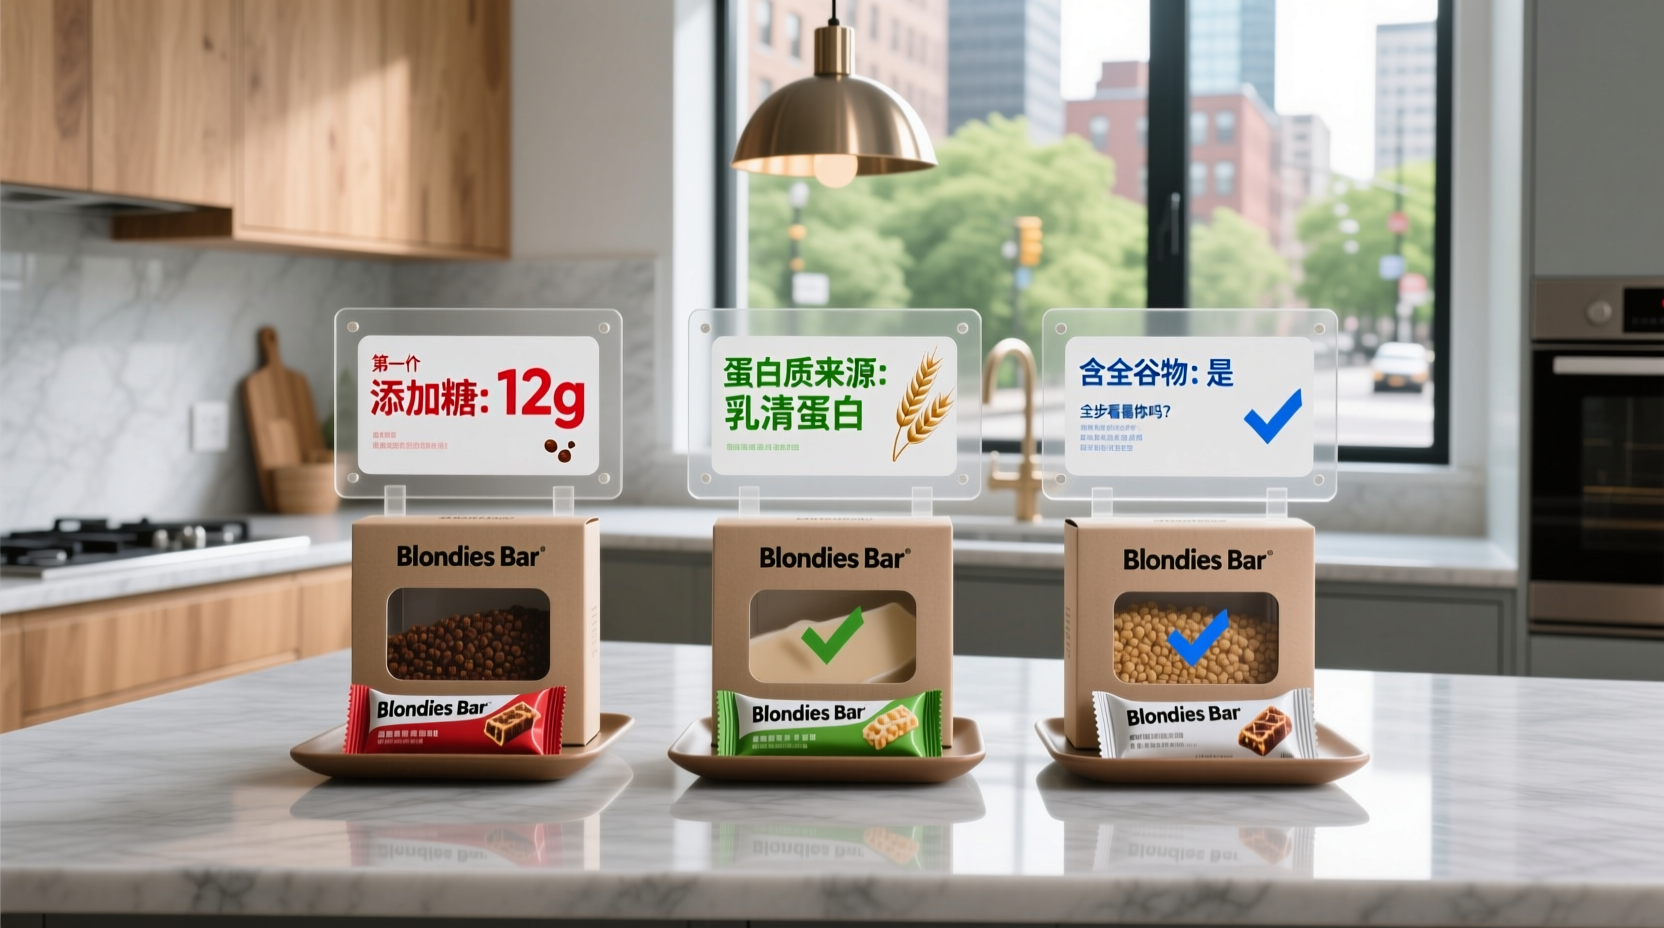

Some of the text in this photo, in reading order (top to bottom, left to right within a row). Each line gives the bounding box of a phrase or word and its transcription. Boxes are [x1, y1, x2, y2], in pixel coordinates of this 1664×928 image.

[1206, 358, 1234, 387] 是
[370, 367, 585, 430] 添加糖: 12g
[725, 394, 863, 431] 乳清蛋白
[397, 545, 495, 567] Blondies
[760, 546, 859, 569] Blondies
[1123, 548, 1222, 570] Blondies
[377, 700, 453, 719] Blondies
[752, 704, 830, 723] Blondies
[1127, 705, 1206, 726] Blondies
